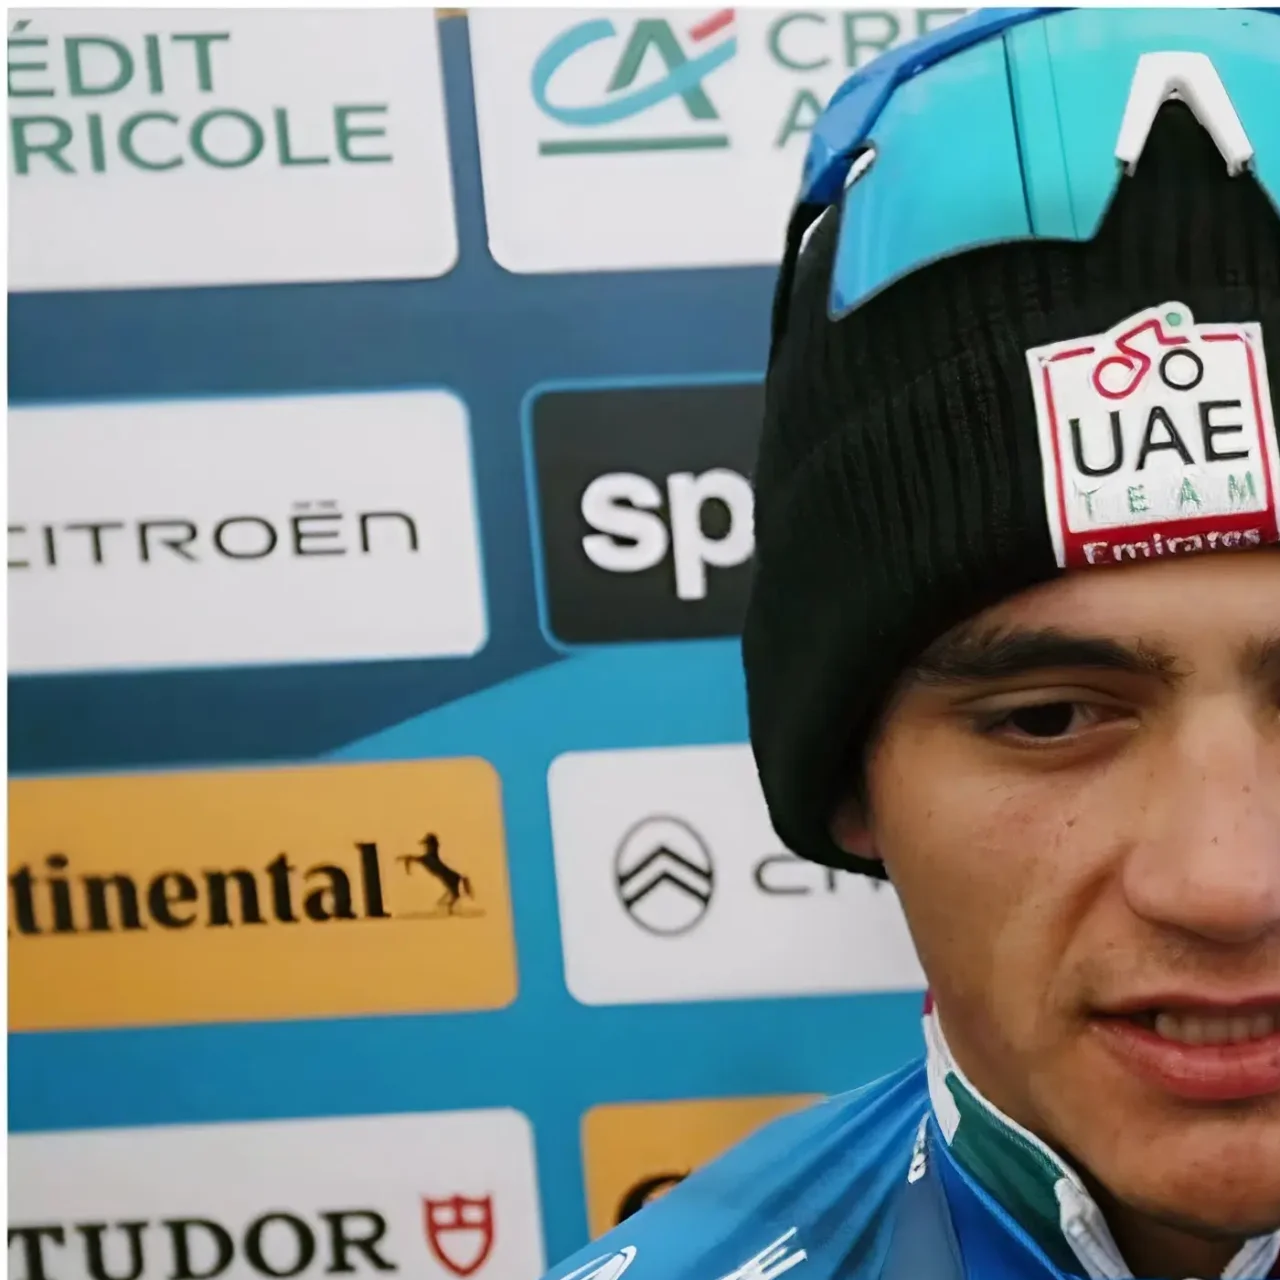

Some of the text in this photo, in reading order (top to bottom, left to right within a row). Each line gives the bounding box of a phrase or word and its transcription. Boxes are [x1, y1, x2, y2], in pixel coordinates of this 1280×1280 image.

[10, 104, 394, 176] RICOLE
[1068, 399, 1250, 477] UAE
[1073, 471, 1256, 516] TEAM
[581, 467, 756, 601] sp
[8, 841, 392, 936] tinental
